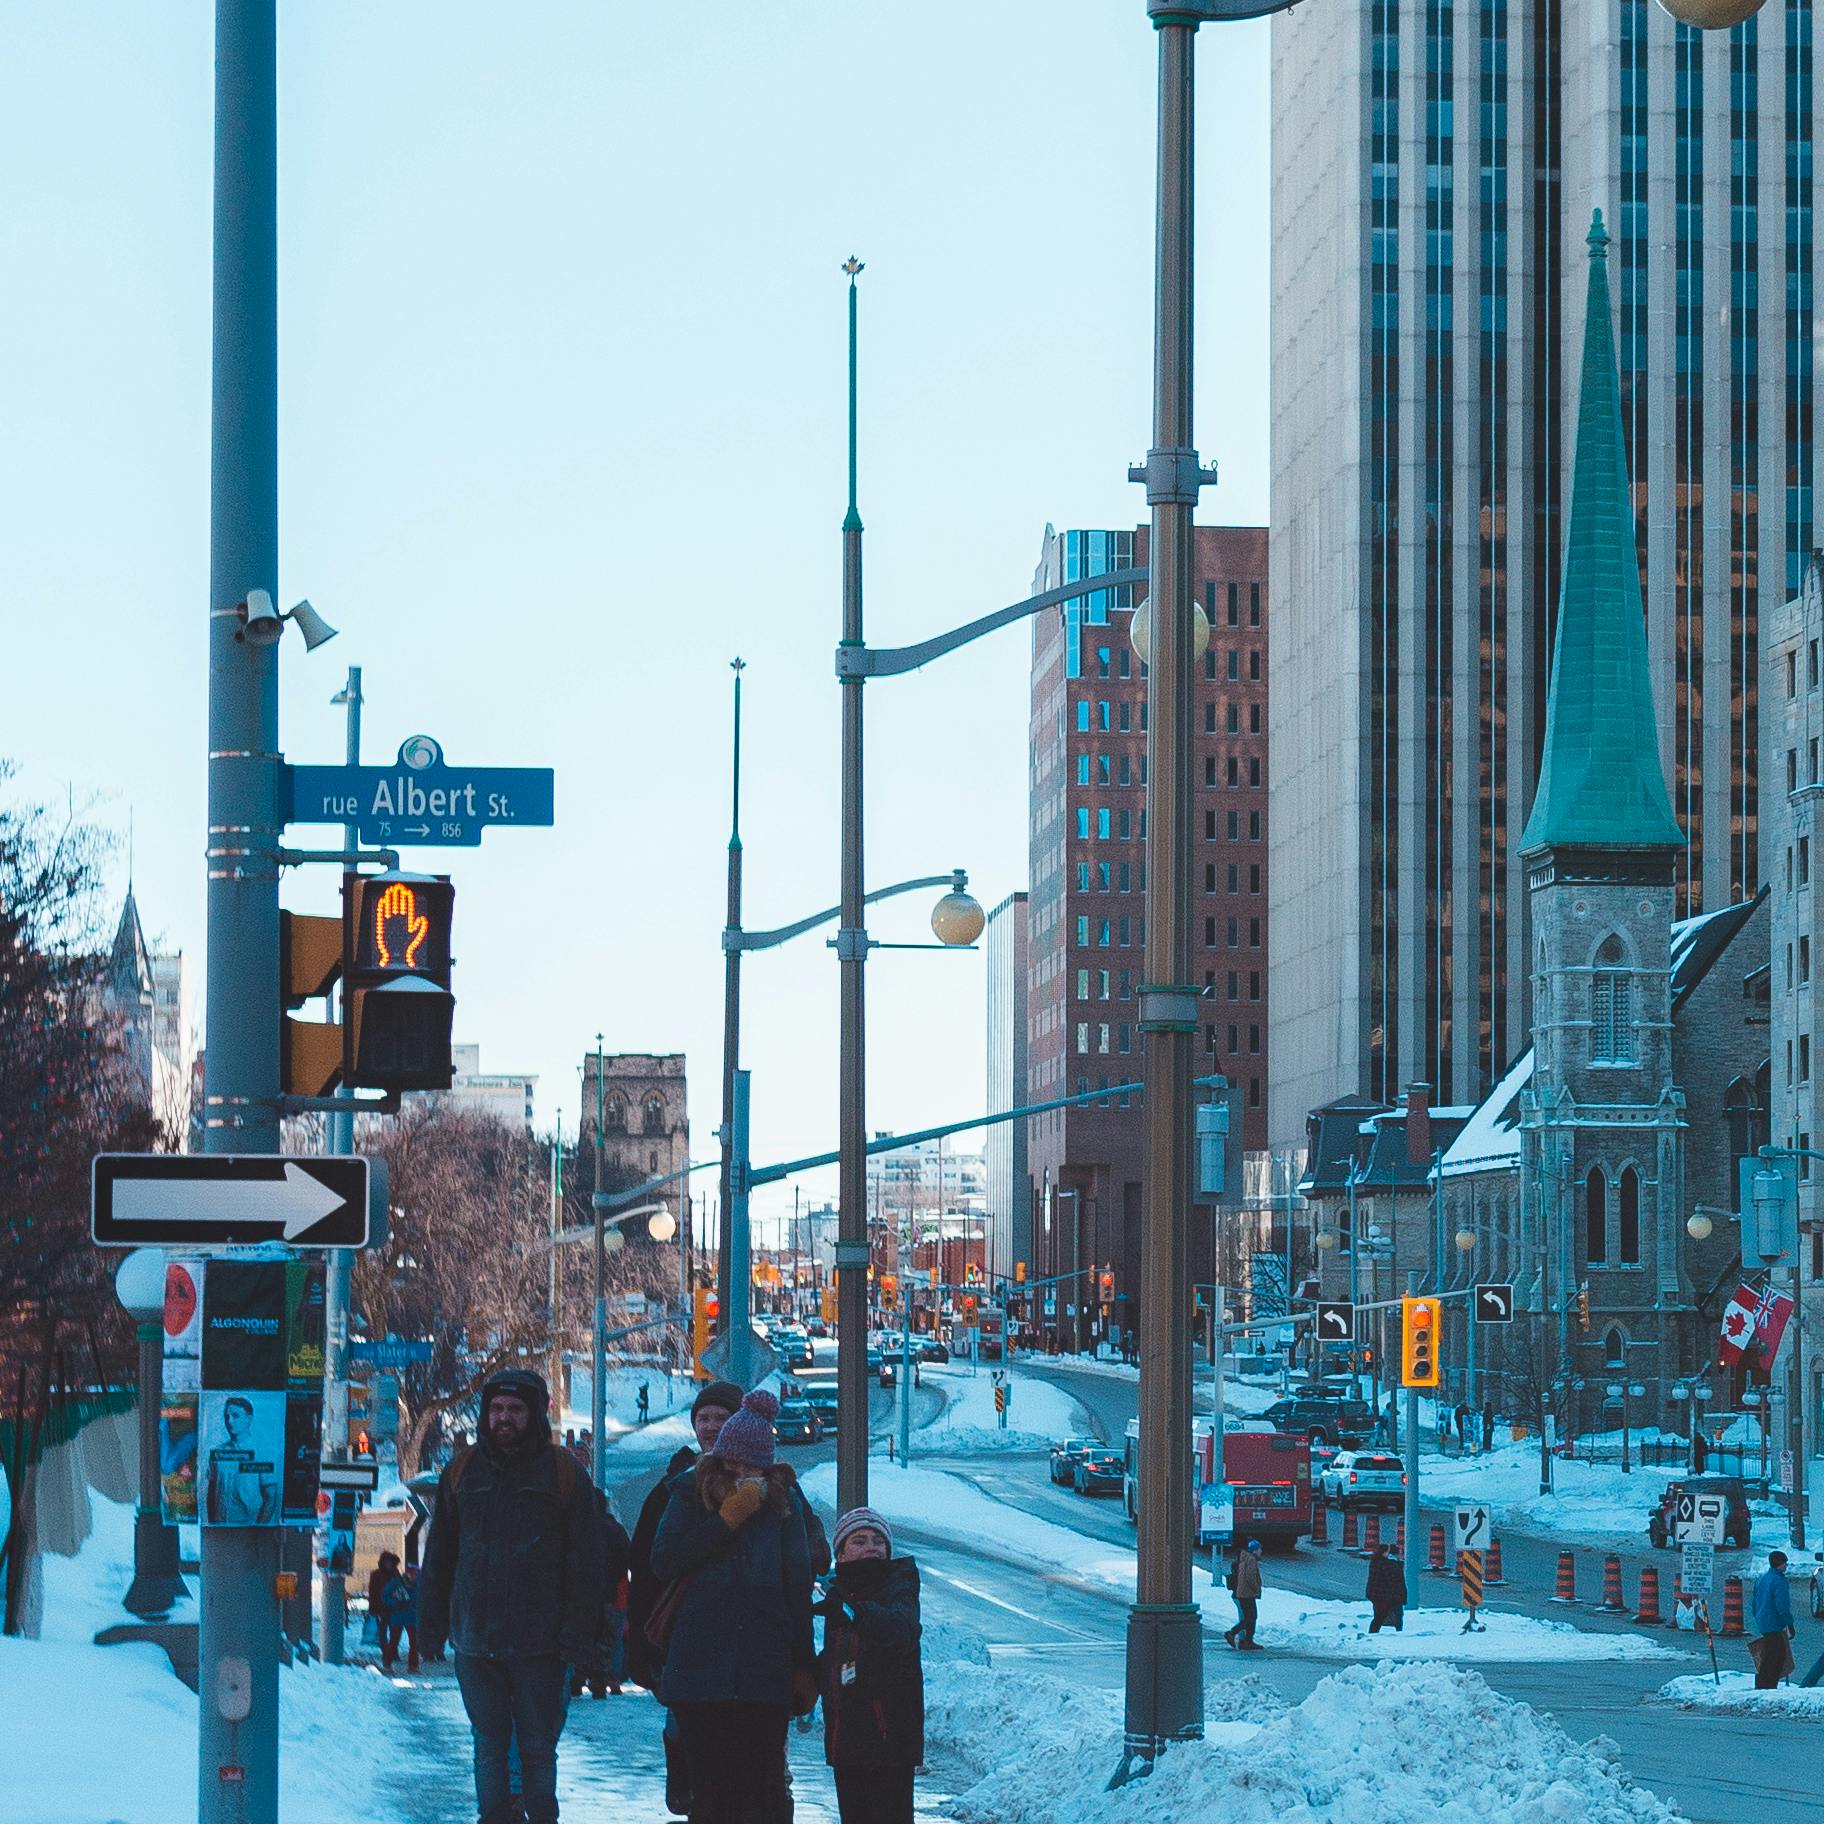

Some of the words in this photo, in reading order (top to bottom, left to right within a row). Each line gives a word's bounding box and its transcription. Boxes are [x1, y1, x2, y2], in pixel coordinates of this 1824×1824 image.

[322, 796, 358, 815] rue
[371, 777, 476, 817] Albert
[488, 793, 515, 817] St.
[378, 821, 391, 837] 75
[441, 822, 462, 838] 856
[211, 1317, 279, 1329] ALGONQUIN
